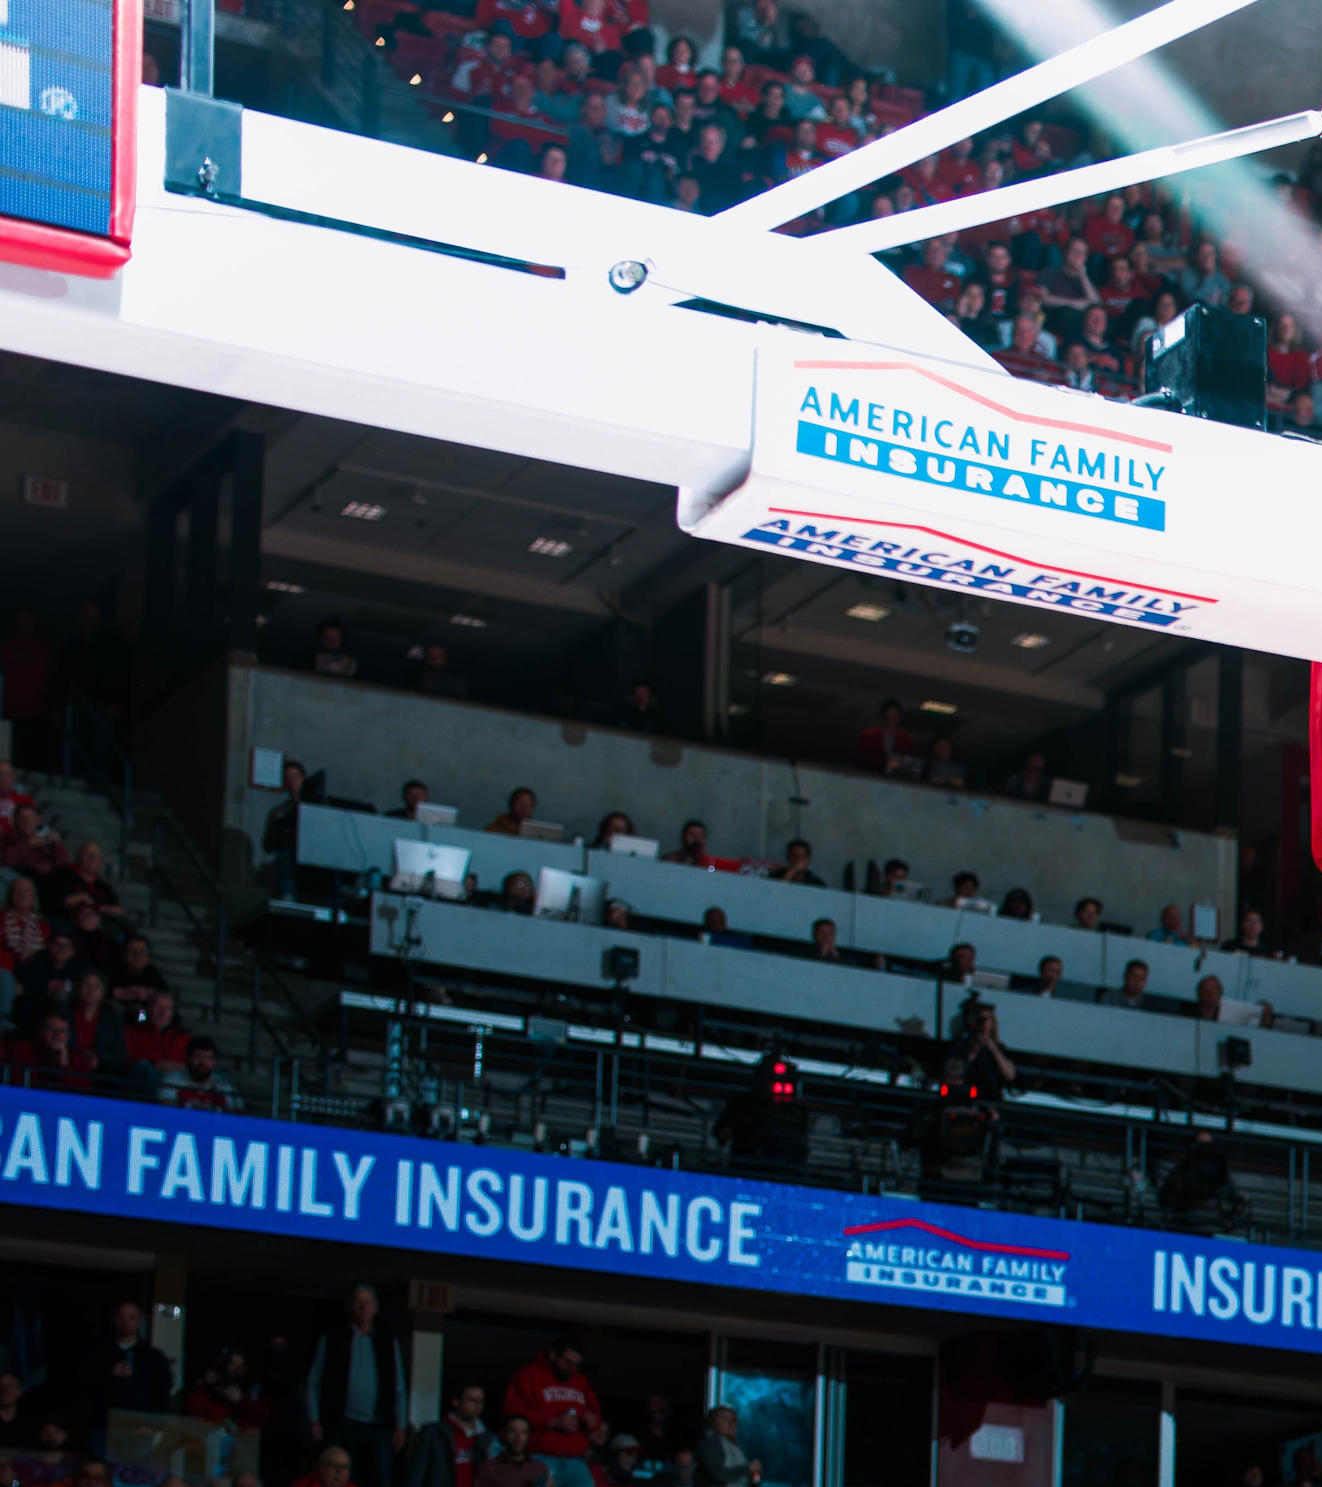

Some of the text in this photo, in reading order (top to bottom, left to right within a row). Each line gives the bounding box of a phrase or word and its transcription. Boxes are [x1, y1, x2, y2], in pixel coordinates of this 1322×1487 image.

[800, 386, 1166, 492] AMERICAN FAMILY
[824, 433, 1141, 522] INSURANCE
[759, 518, 1198, 617] AMERICAN FAMILY
[776, 537, 1148, 622] INSURANCE
[0, 1112, 763, 1268] AN FAMILY INSURANCE
[847, 1241, 1066, 1283] AMERICAN FAMILY
[861, 1267, 1049, 1300] INSURANCE
